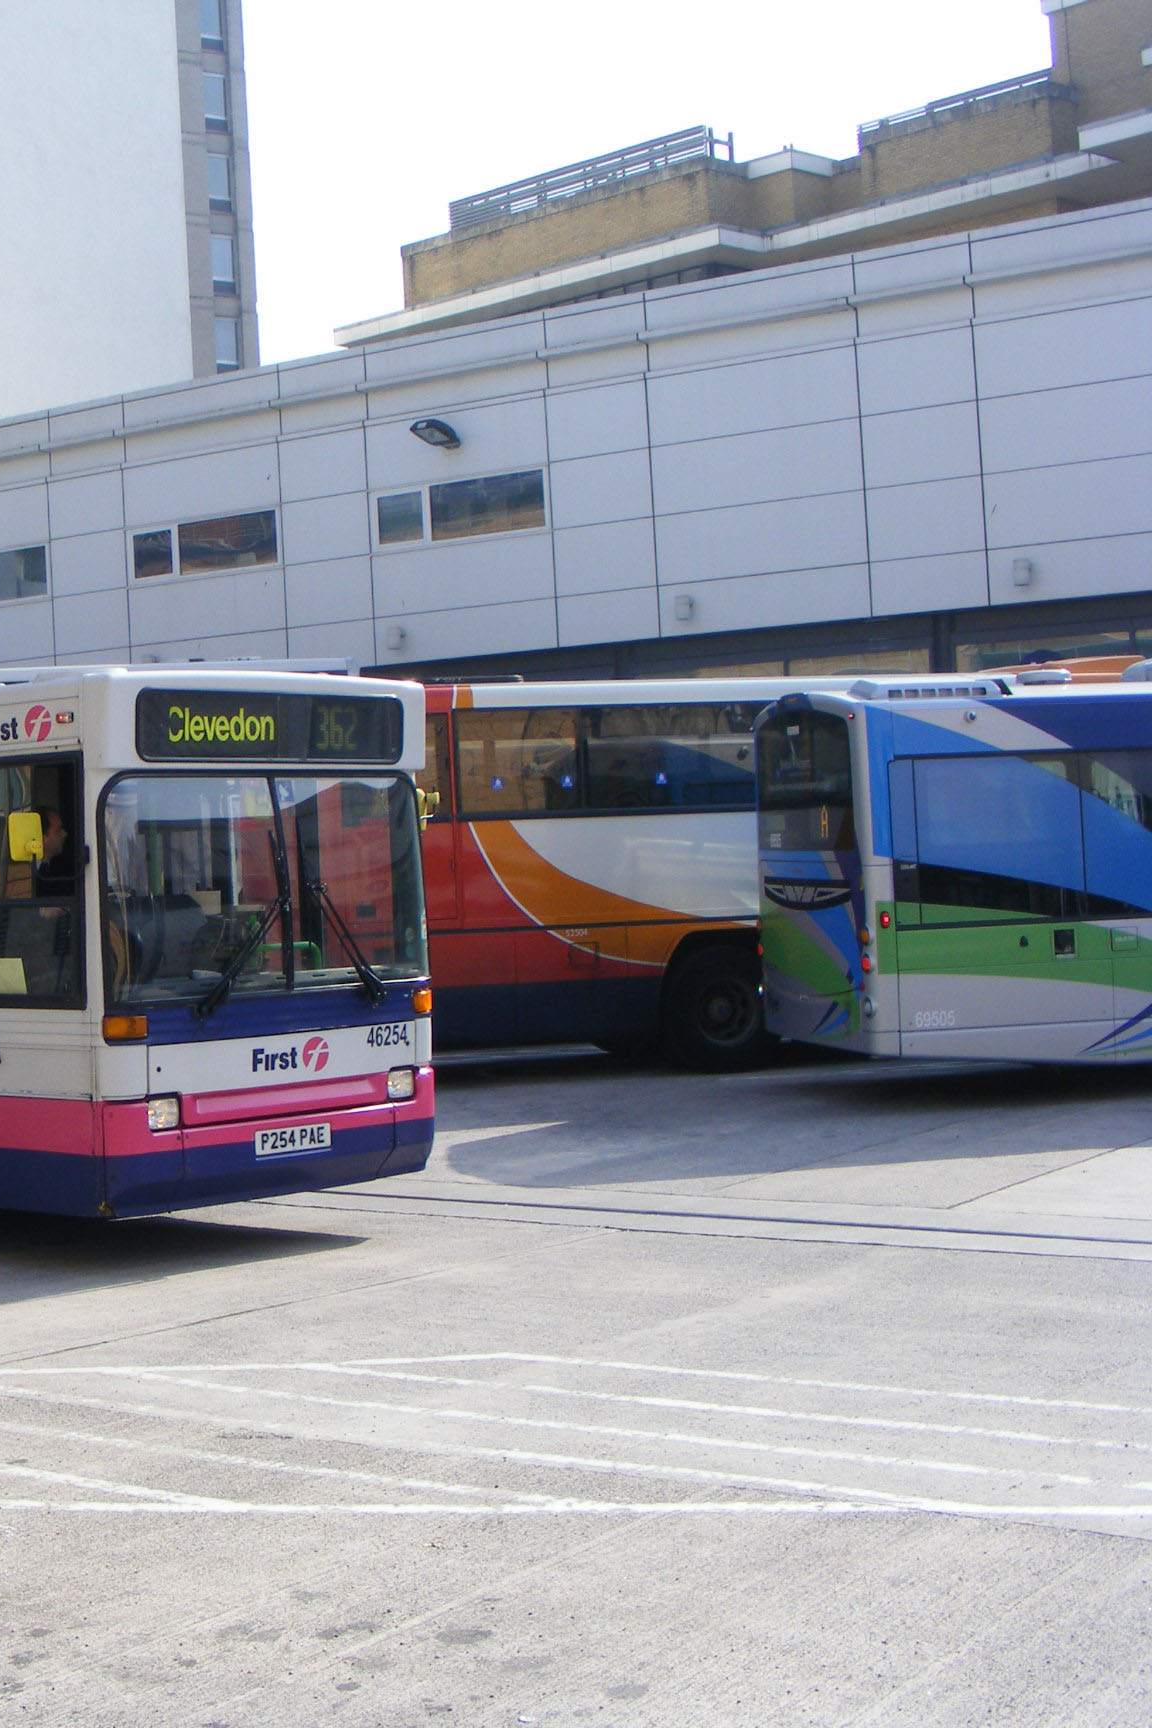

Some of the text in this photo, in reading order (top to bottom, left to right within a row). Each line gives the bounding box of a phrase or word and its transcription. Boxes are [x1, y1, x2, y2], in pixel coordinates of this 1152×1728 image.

[168, 705, 275, 743] Clevedon
[367, 1023, 407, 1048] 46254
[252, 1047, 297, 1072] First
[261, 1126, 325, 1150] P254 PAE
